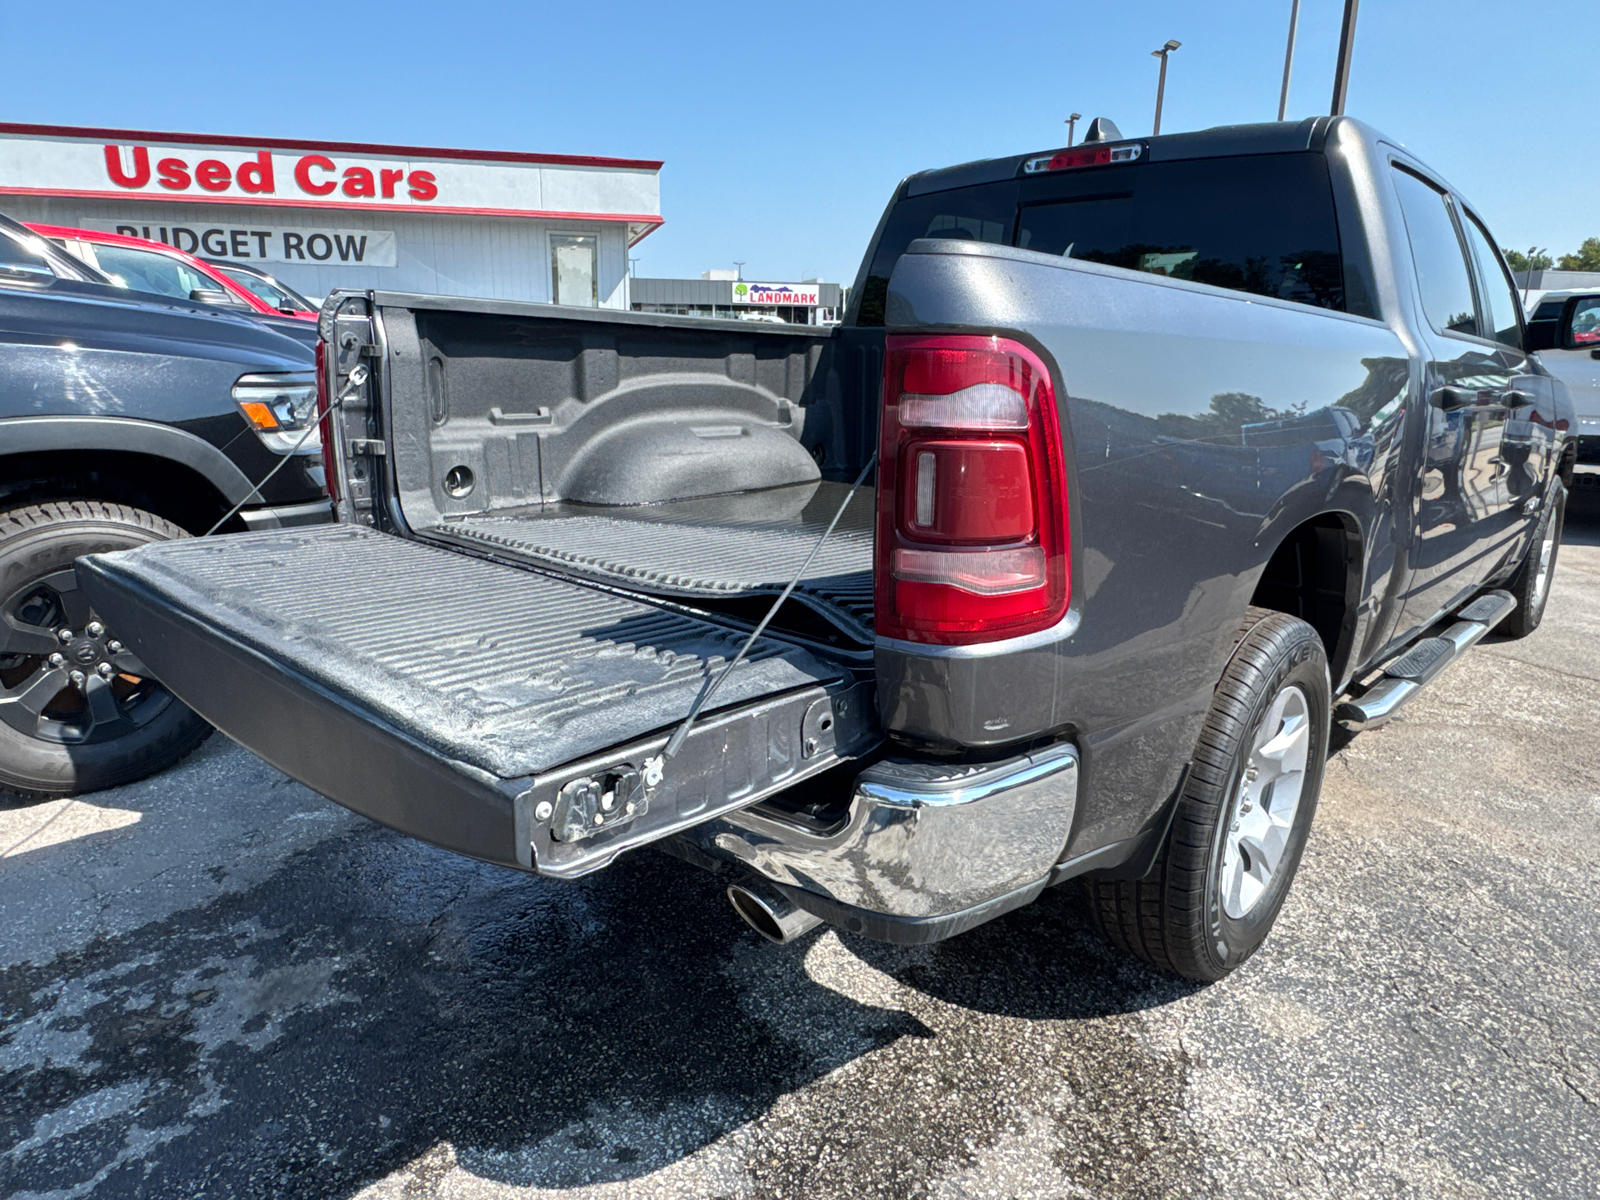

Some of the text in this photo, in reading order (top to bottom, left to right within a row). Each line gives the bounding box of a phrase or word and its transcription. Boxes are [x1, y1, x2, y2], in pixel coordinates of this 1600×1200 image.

[104, 144, 438, 200] Used Cars
[283, 232, 368, 262] ROW
[749, 292, 816, 304] LANDMARK
